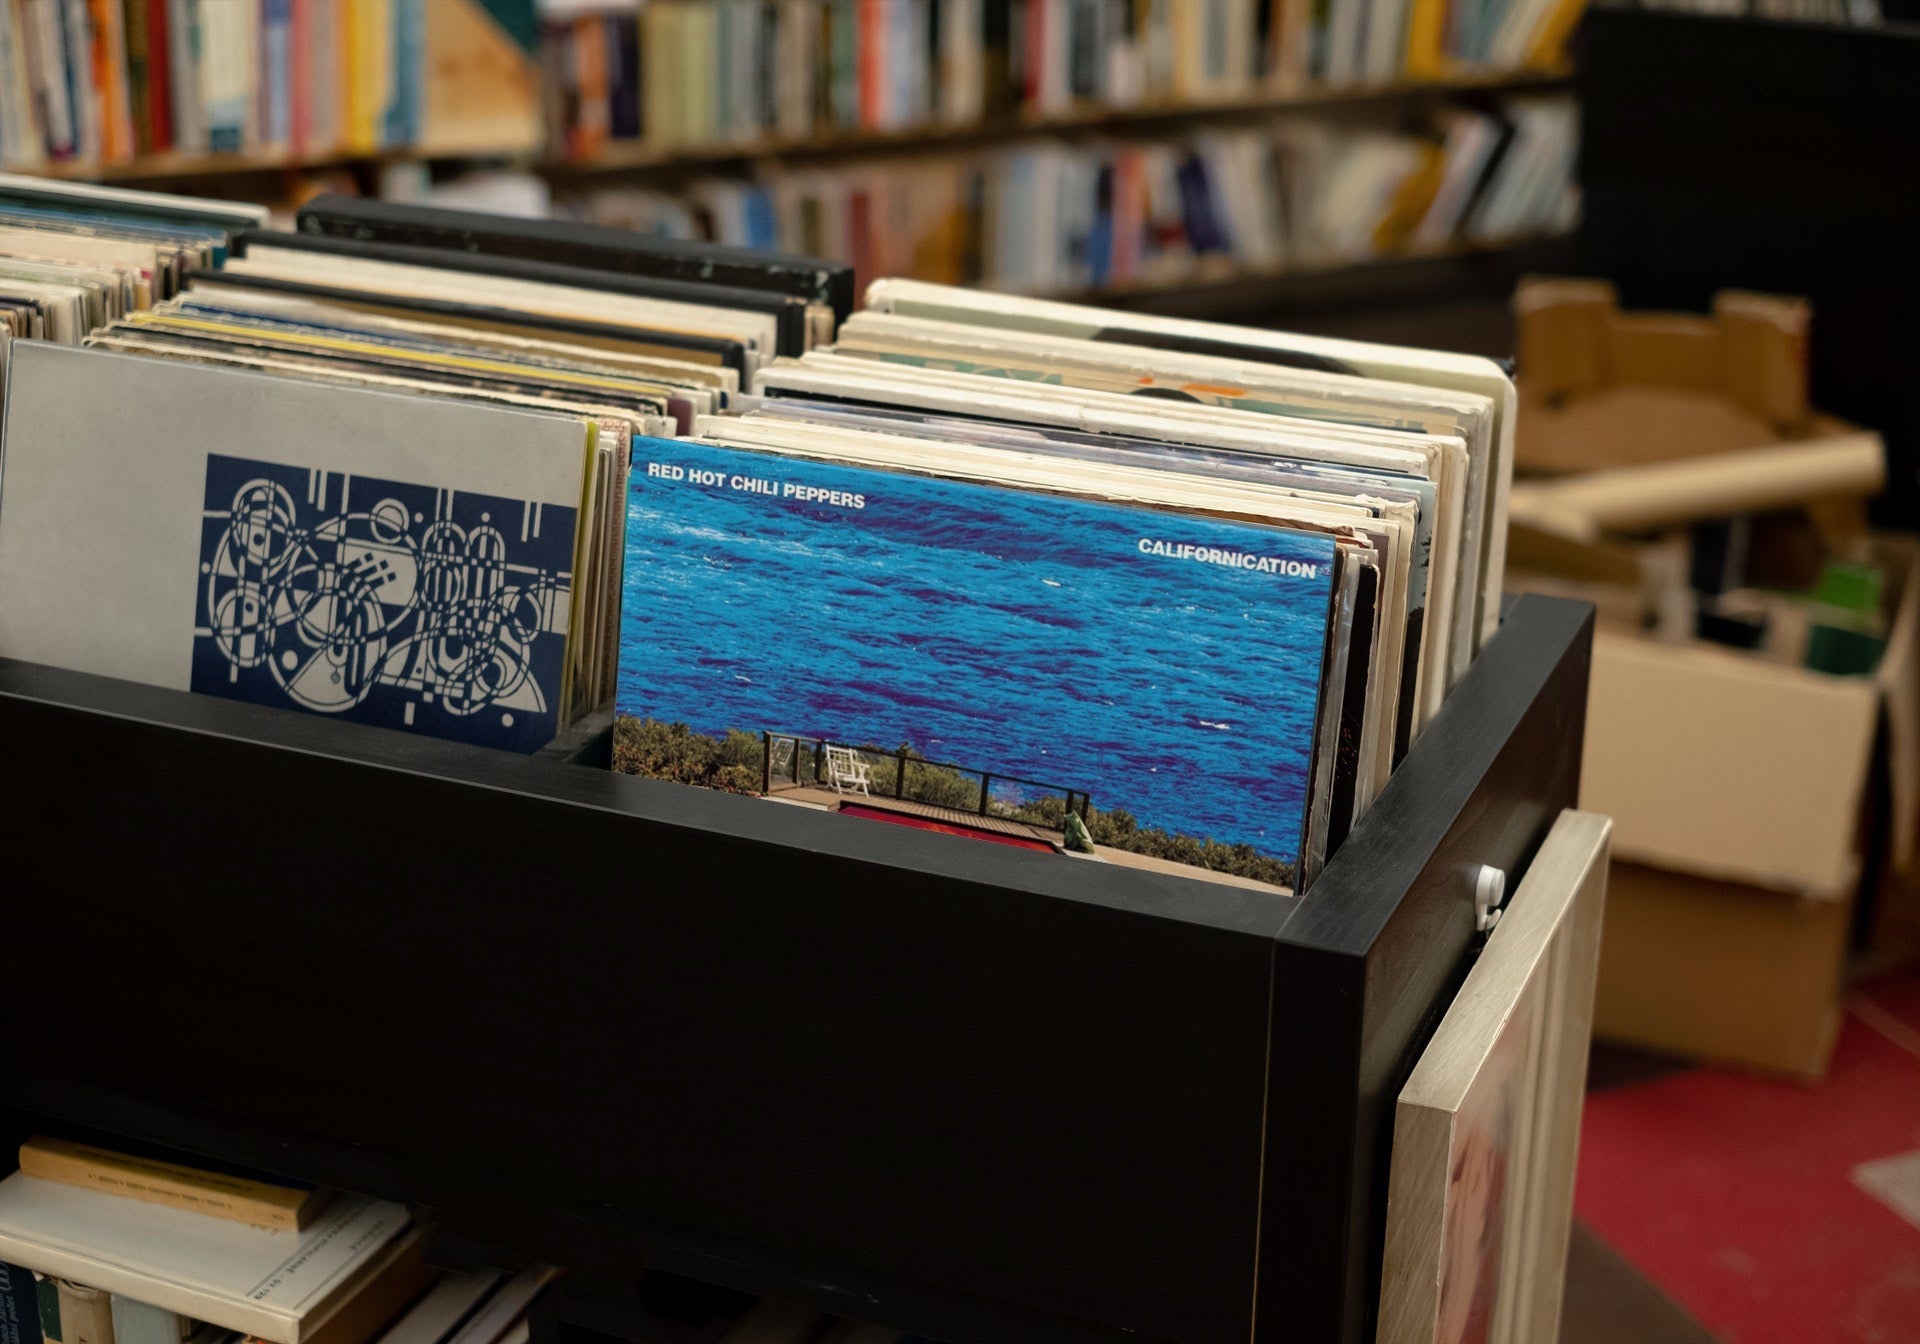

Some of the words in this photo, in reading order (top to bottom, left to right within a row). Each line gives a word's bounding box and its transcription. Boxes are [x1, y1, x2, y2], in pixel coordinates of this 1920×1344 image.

[648, 462, 684, 480] RED
[688, 469, 726, 487] HOT
[731, 476, 778, 496] CHILI
[783, 483, 865, 509] PEPPERS
[1138, 538, 1317, 579] CALIFORNICATION
